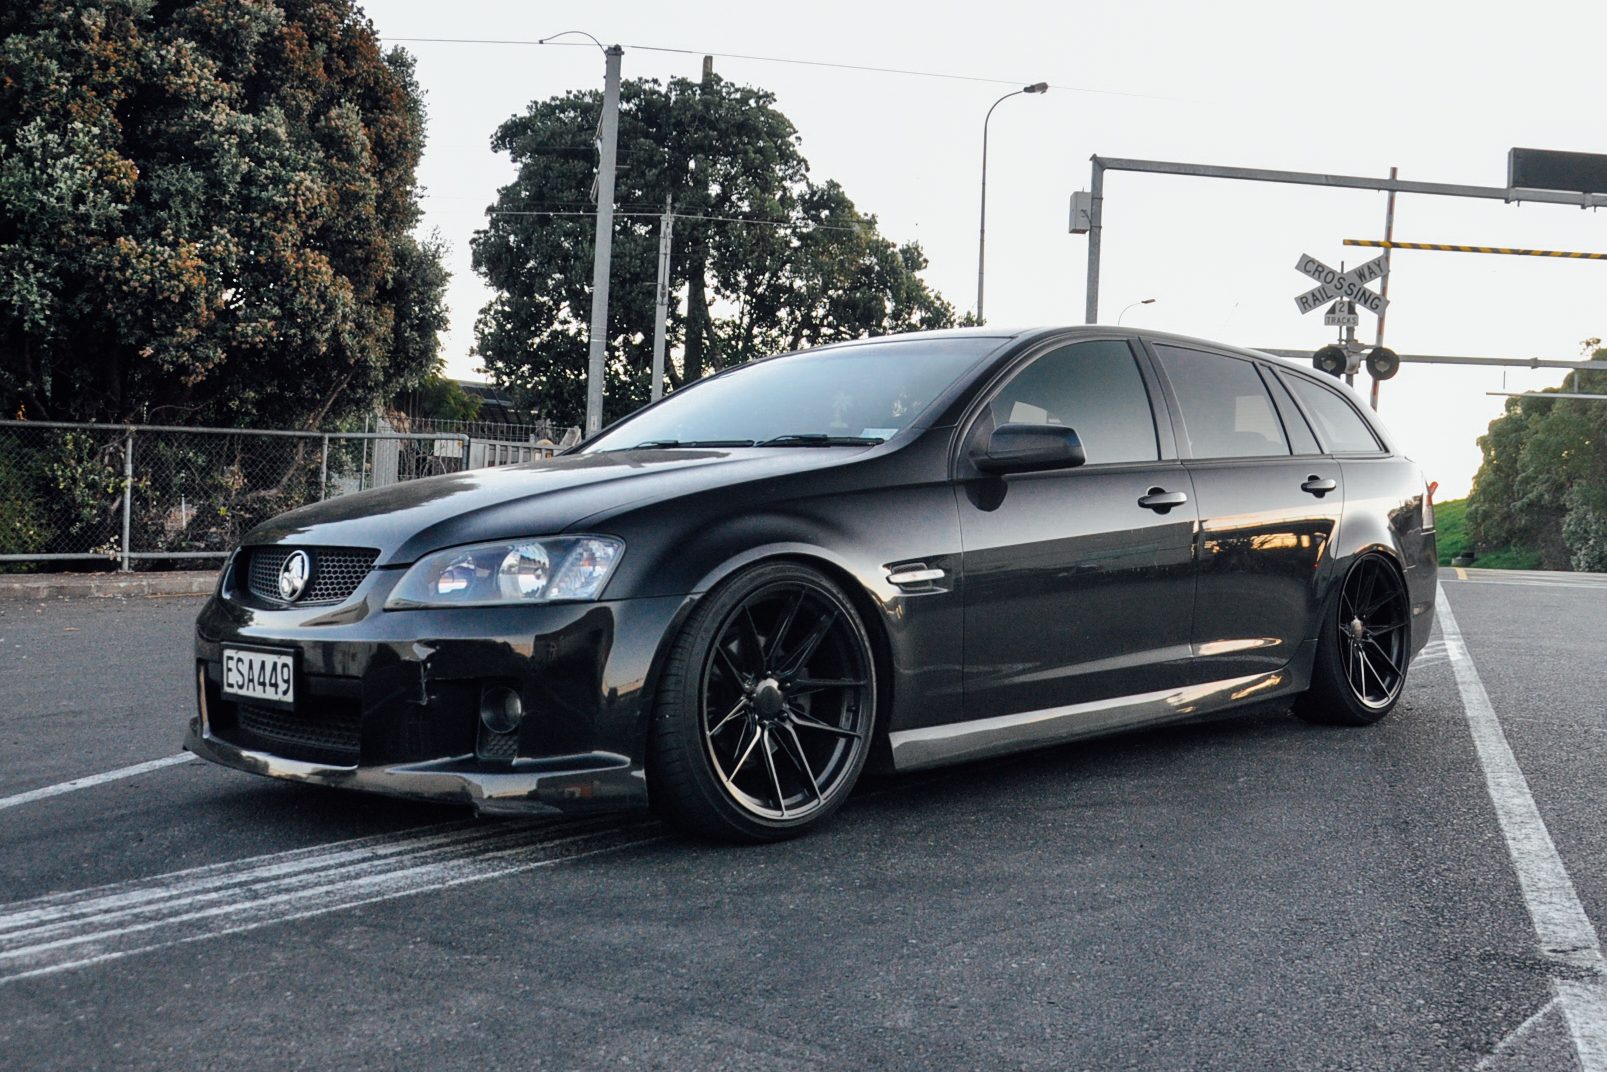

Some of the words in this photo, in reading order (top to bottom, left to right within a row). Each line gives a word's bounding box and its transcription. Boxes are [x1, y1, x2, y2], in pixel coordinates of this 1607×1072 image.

[1300, 286, 1334, 311] RAIL
[1354, 260, 1384, 283] WAY
[1303, 259, 1382, 311] CROSSING
[1327, 316, 1357, 325] TRACKS
[1338, 302, 1345, 313] 2
[226, 655, 290, 696] ESA449
